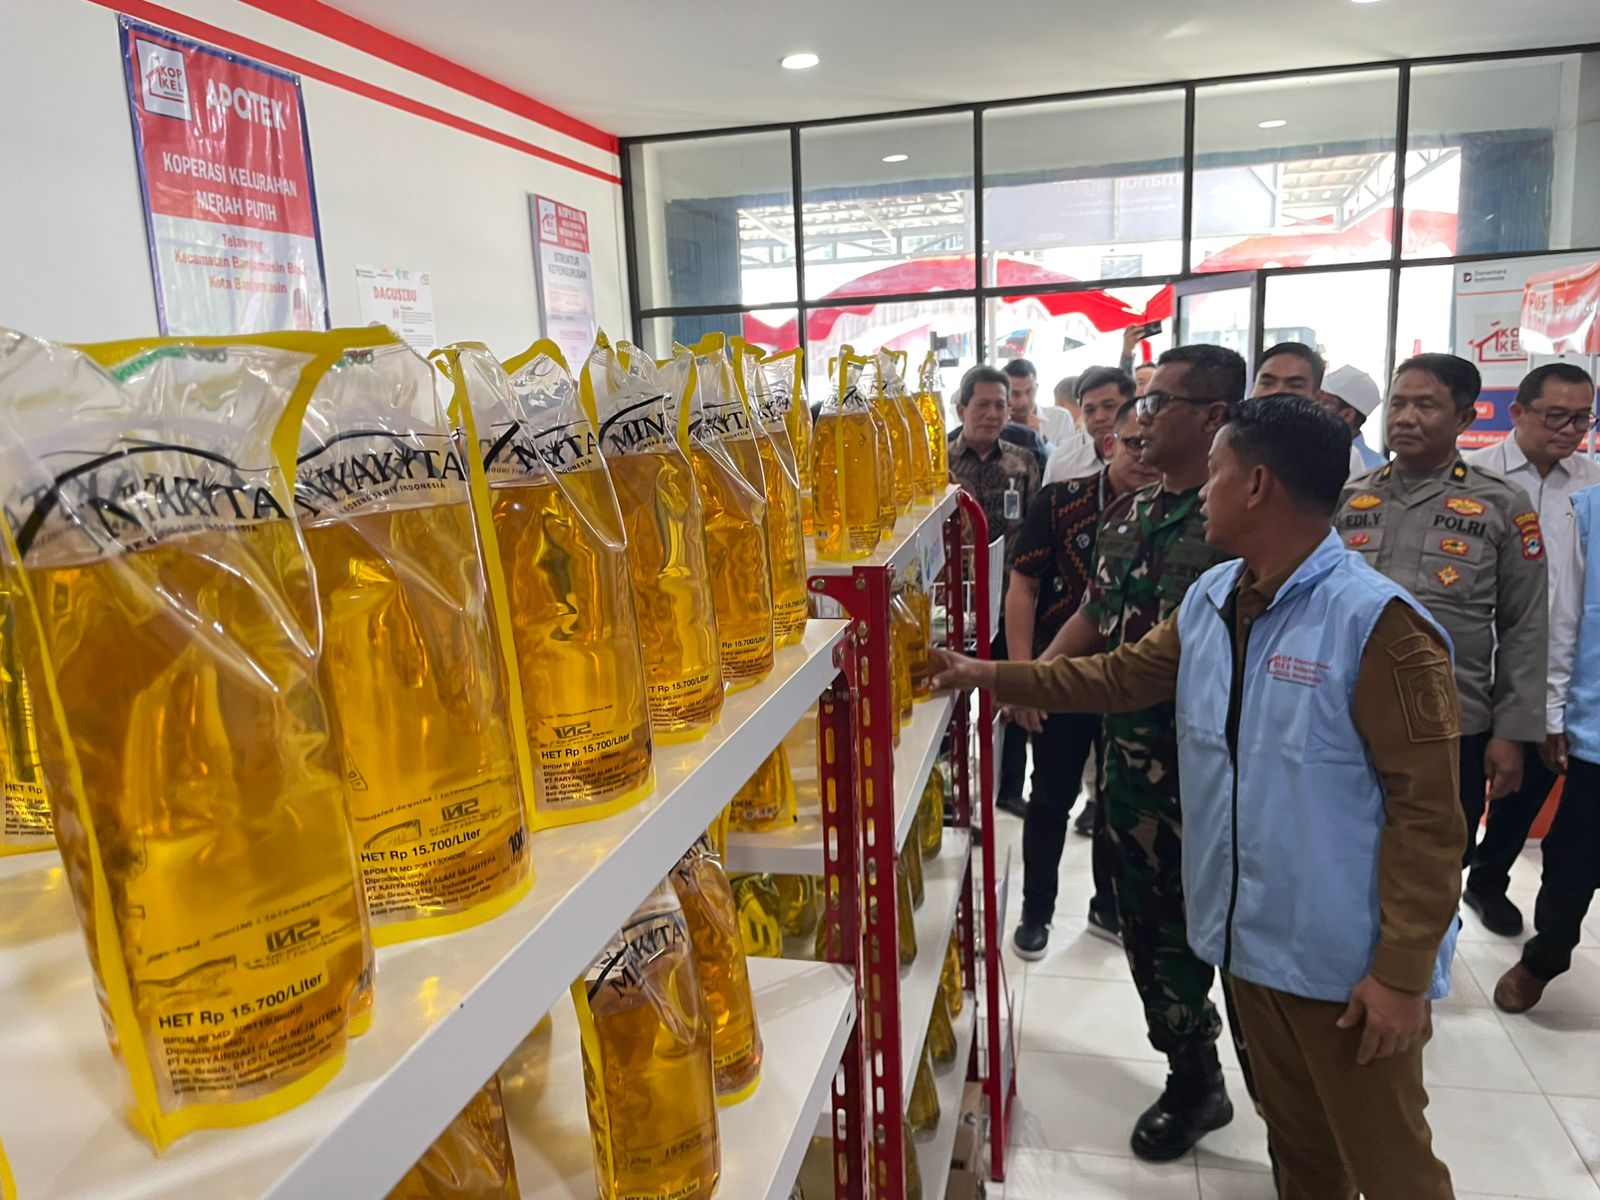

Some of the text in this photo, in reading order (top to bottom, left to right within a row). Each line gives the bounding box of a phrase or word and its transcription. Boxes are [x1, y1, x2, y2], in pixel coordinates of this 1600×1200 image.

[160, 66, 182, 80] KOP
[161, 79, 184, 92] KEL
[206, 78, 287, 131] APOTEK
[163, 152, 298, 197] KOPERASI KELURAHAN
[196, 190, 277, 222] MERAH PUTIH
[1500, 327, 1519, 338] KO
[1500, 341, 1520, 352] KE
[1433, 514, 1487, 537] POLRI
[541, 749, 562, 760] HET
[565, 748, 580, 758] Rp
[583, 733, 630, 754] 15.700/Liter
[361, 828, 481, 862] HET Rp 15.700/Liter
[159, 1012, 194, 1028] HET
[200, 1010, 224, 1026] Rp
[231, 973, 322, 1018] 15.700/Liter
